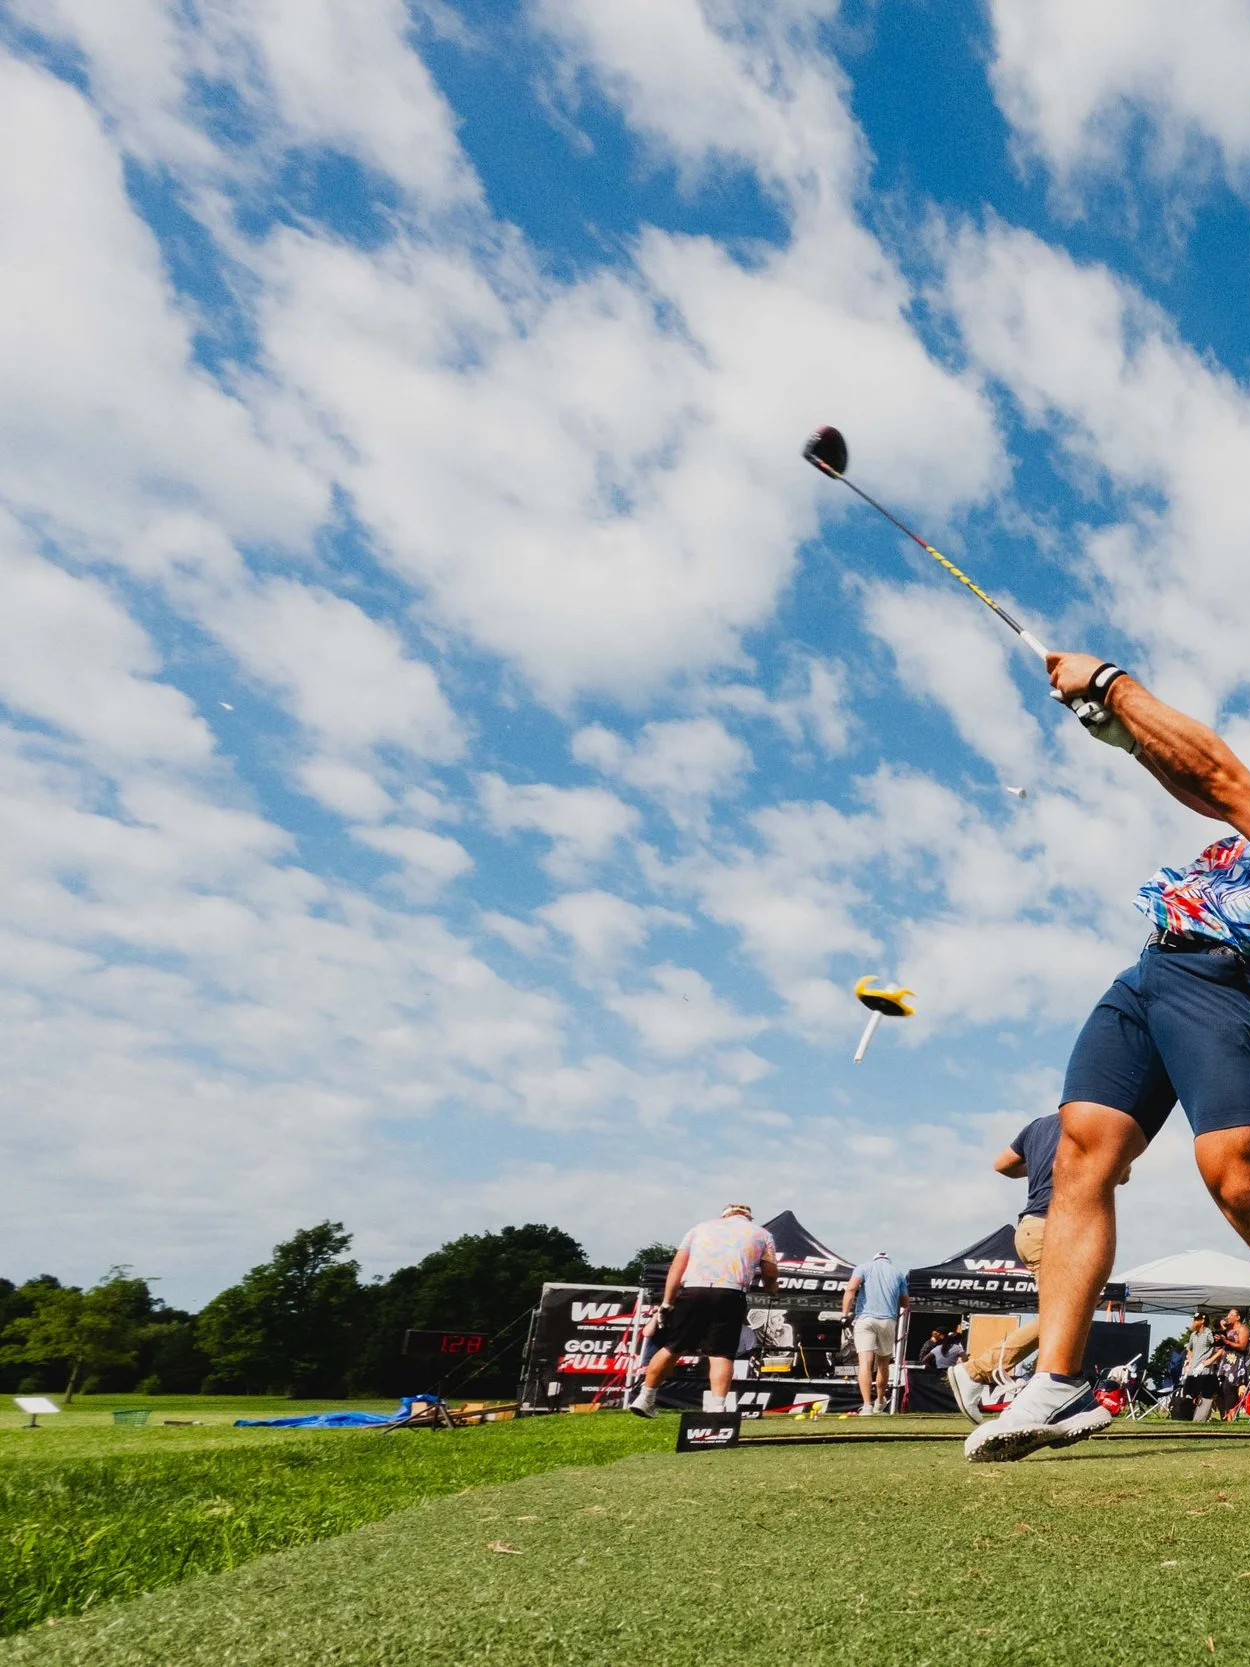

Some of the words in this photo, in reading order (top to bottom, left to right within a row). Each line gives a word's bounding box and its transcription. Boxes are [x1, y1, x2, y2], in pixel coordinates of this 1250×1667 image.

[930, 1278, 999, 1291] WORLD
[1003, 1281, 1039, 1292] LON
[564, 1340, 613, 1353] GOLF
[559, 1353, 610, 1371] FULL
[687, 1427, 734, 1441] WLD
